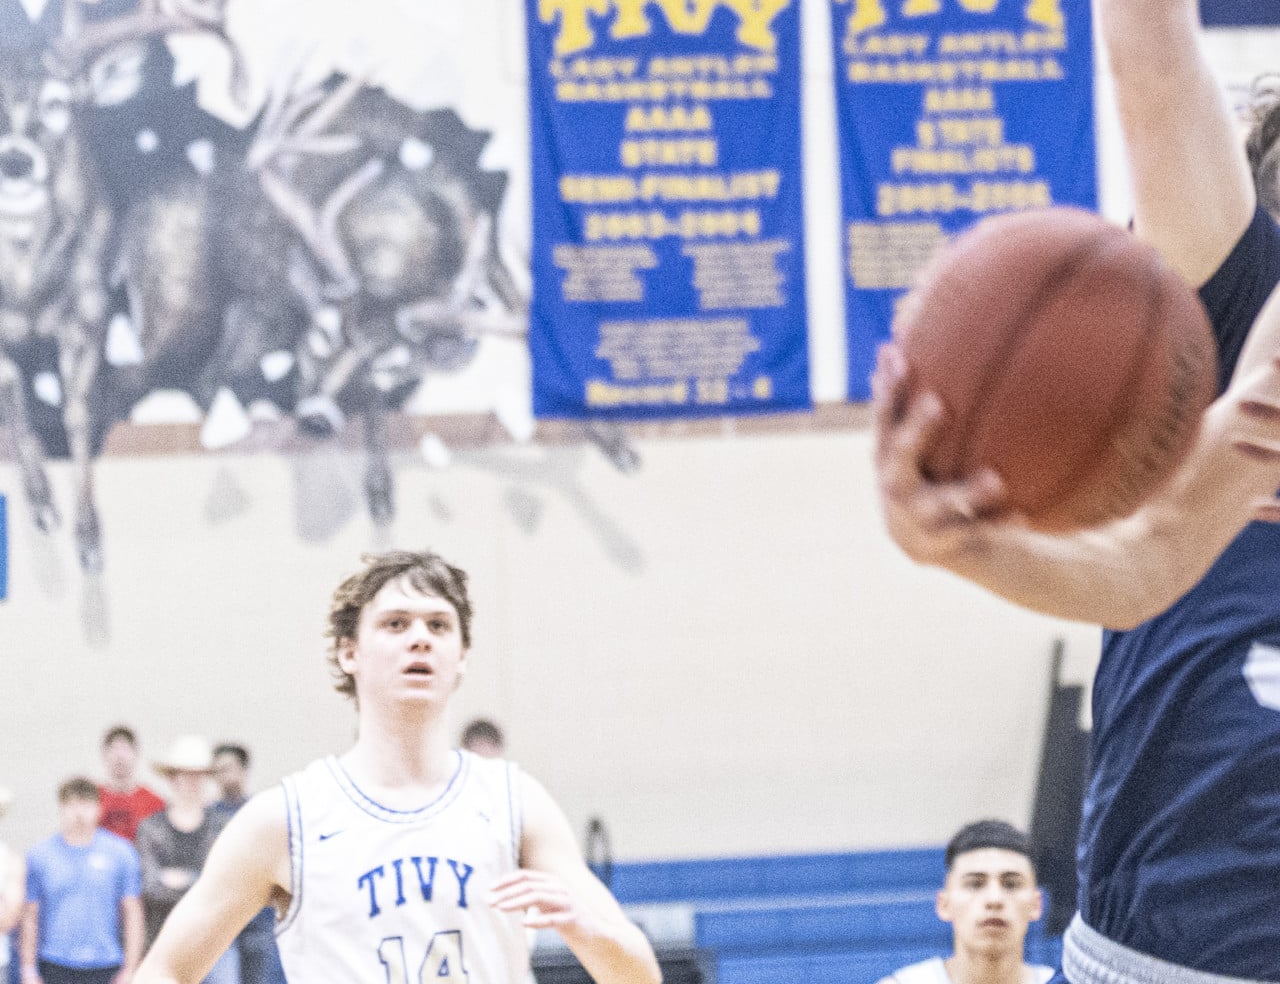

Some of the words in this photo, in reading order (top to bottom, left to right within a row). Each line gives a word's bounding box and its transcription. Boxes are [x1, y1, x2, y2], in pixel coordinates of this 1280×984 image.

[621, 138, 718, 167] STATE
[357, 856, 475, 919] TIVY
[376, 929, 470, 984] 14
